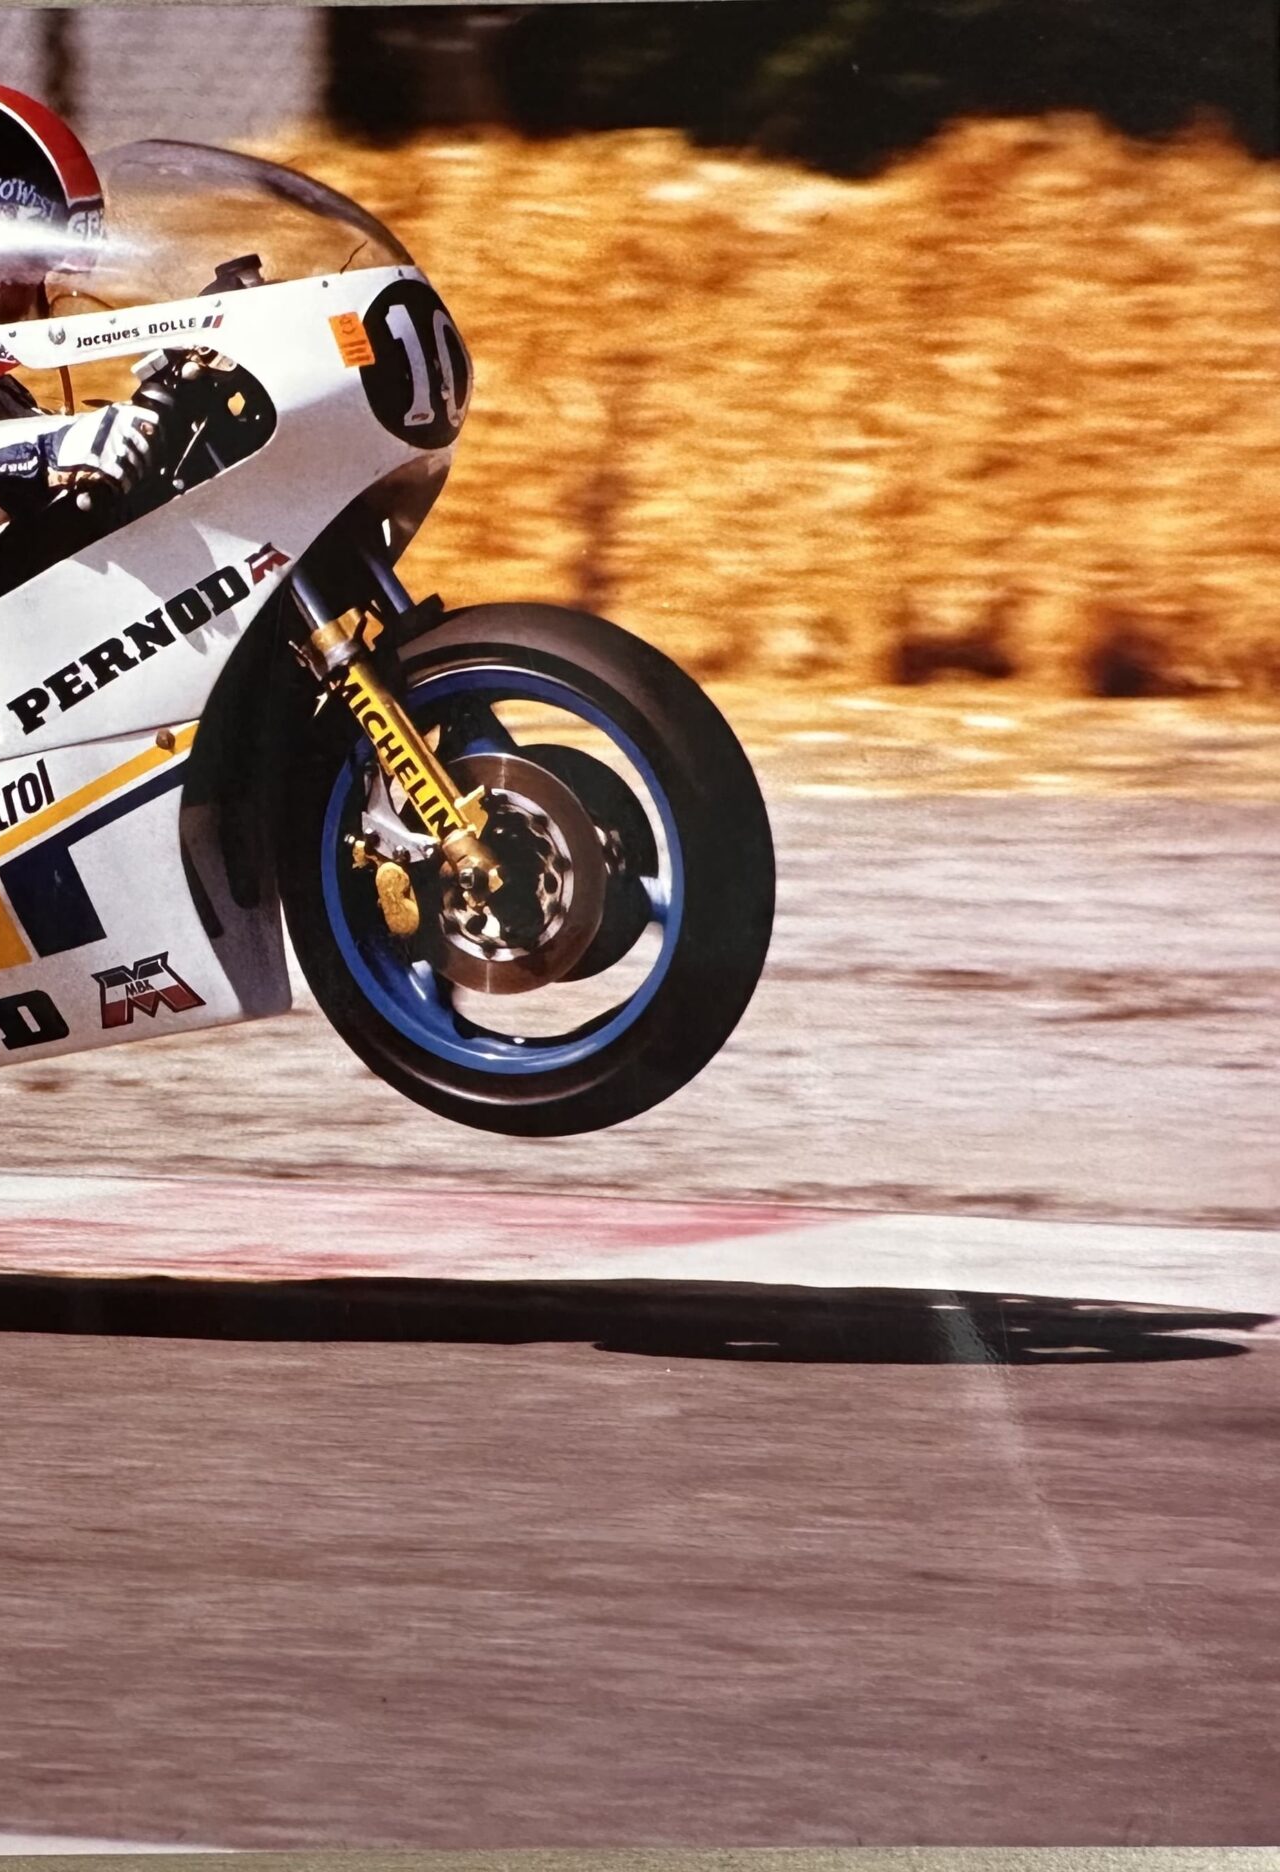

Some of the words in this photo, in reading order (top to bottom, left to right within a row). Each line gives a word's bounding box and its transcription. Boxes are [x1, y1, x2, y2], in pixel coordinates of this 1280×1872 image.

[76, 327, 140, 348] Jacques
[148, 317, 196, 335] BOLLE
[384, 303, 474, 428] 10
[6, 564, 251, 735] PERNOD
[329, 668, 458, 840] MICHELIN
